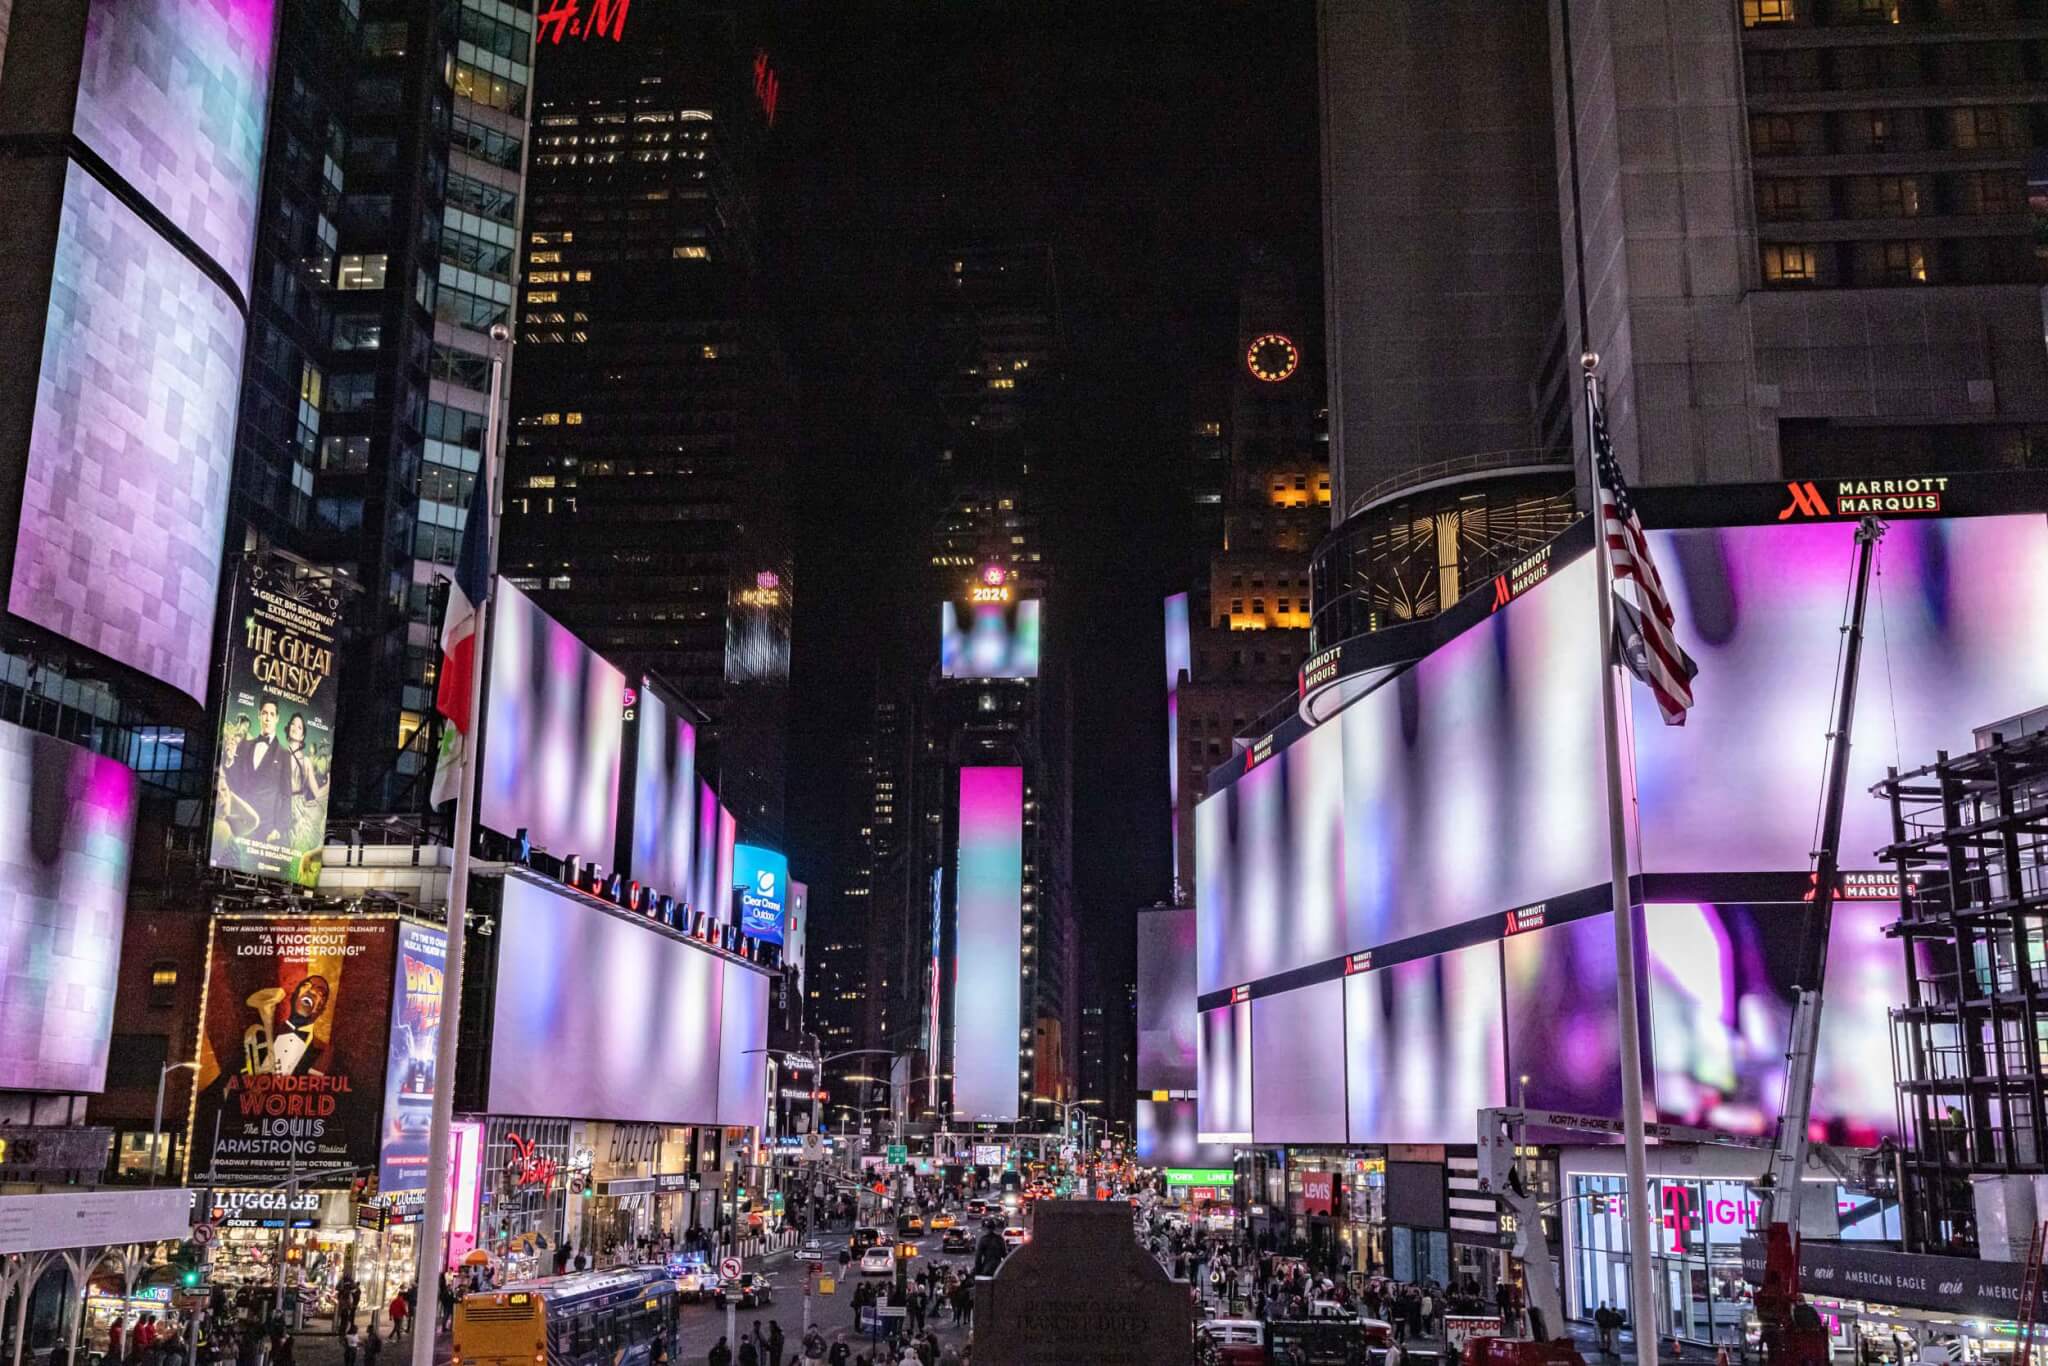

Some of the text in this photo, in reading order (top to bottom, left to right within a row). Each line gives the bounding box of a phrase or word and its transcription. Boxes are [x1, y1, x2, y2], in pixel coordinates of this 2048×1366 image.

[537, 0, 630, 45] H&M
[1839, 478, 1948, 495] MARRIOTT
[1840, 496, 1937, 511] MARQUIS
[1512, 544, 1551, 579] MARRIOTT
[1512, 564, 1547, 595] MARQUIS
[973, 588, 1008, 601] 2024
[260, 590, 284, 606] GREAT
[285, 600, 297, 611] BIG
[298, 605, 335, 627] BROADWAY
[268, 603, 321, 632] EXTRAVAGANZA
[247, 622, 278, 657] THE
[279, 634, 335, 677] GREAT
[1305, 646, 1342, 676] MARRIOTT
[253, 654, 322, 697] GATSBY
[1305, 663, 1337, 690] MARQUIS
[263, 684, 309, 706] A NEW MUSICAL
[572, 855, 761, 962] 1540 BROADWAY
[743, 894, 762, 906] Clear
[752, 908, 775, 921] Outdoor
[1518, 903, 1546, 919] MARRIOTT
[1518, 915, 1545, 929] MARQUIS
[276, 934, 346, 945] KNOCKOUT
[237, 945, 274, 956] LOUIS
[226, 1074, 353, 1093] A WONDERFUL
[239, 1094, 336, 1116] WORLD
[243, 1118, 325, 1138] The LOUIS
[1548, 1114, 1577, 1126] NORTH
[1580, 1118, 1608, 1129] SHORE
[216, 1139, 348, 1154] ARMSTRONG Musical
[214, 1192, 320, 1210] LUGGAGE
[1194, 1191, 1211, 1199] SALE
[227, 1219, 258, 1227] SONY
[1814, 1267, 1835, 1279] aerie
[1845, 1270, 1927, 1291] AMERICAN EAGLE
[1938, 1280, 1964, 1295] aerie
[1448, 1320, 1499, 1330] CHICAGO
